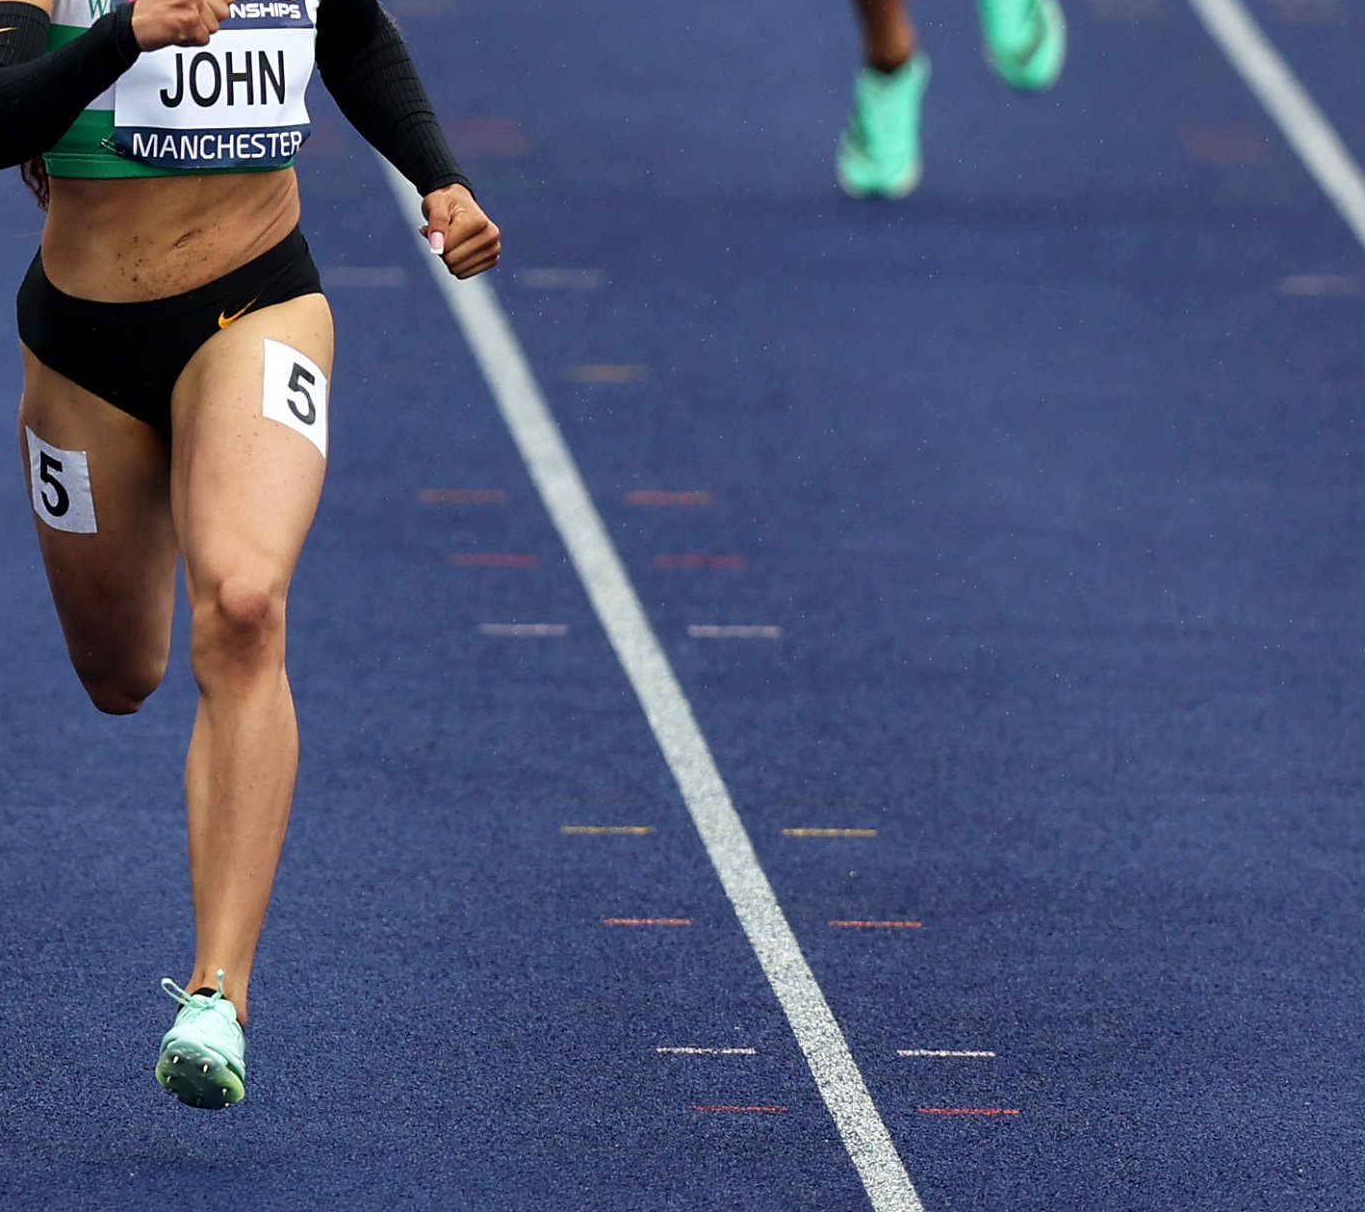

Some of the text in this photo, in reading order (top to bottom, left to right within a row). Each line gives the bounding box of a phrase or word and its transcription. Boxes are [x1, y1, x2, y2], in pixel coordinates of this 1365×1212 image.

[159, 50, 286, 108] JOHN
[132, 131, 303, 160] MANCHESTER
[286, 362, 316, 426] 5
[39, 450, 69, 517] 5
